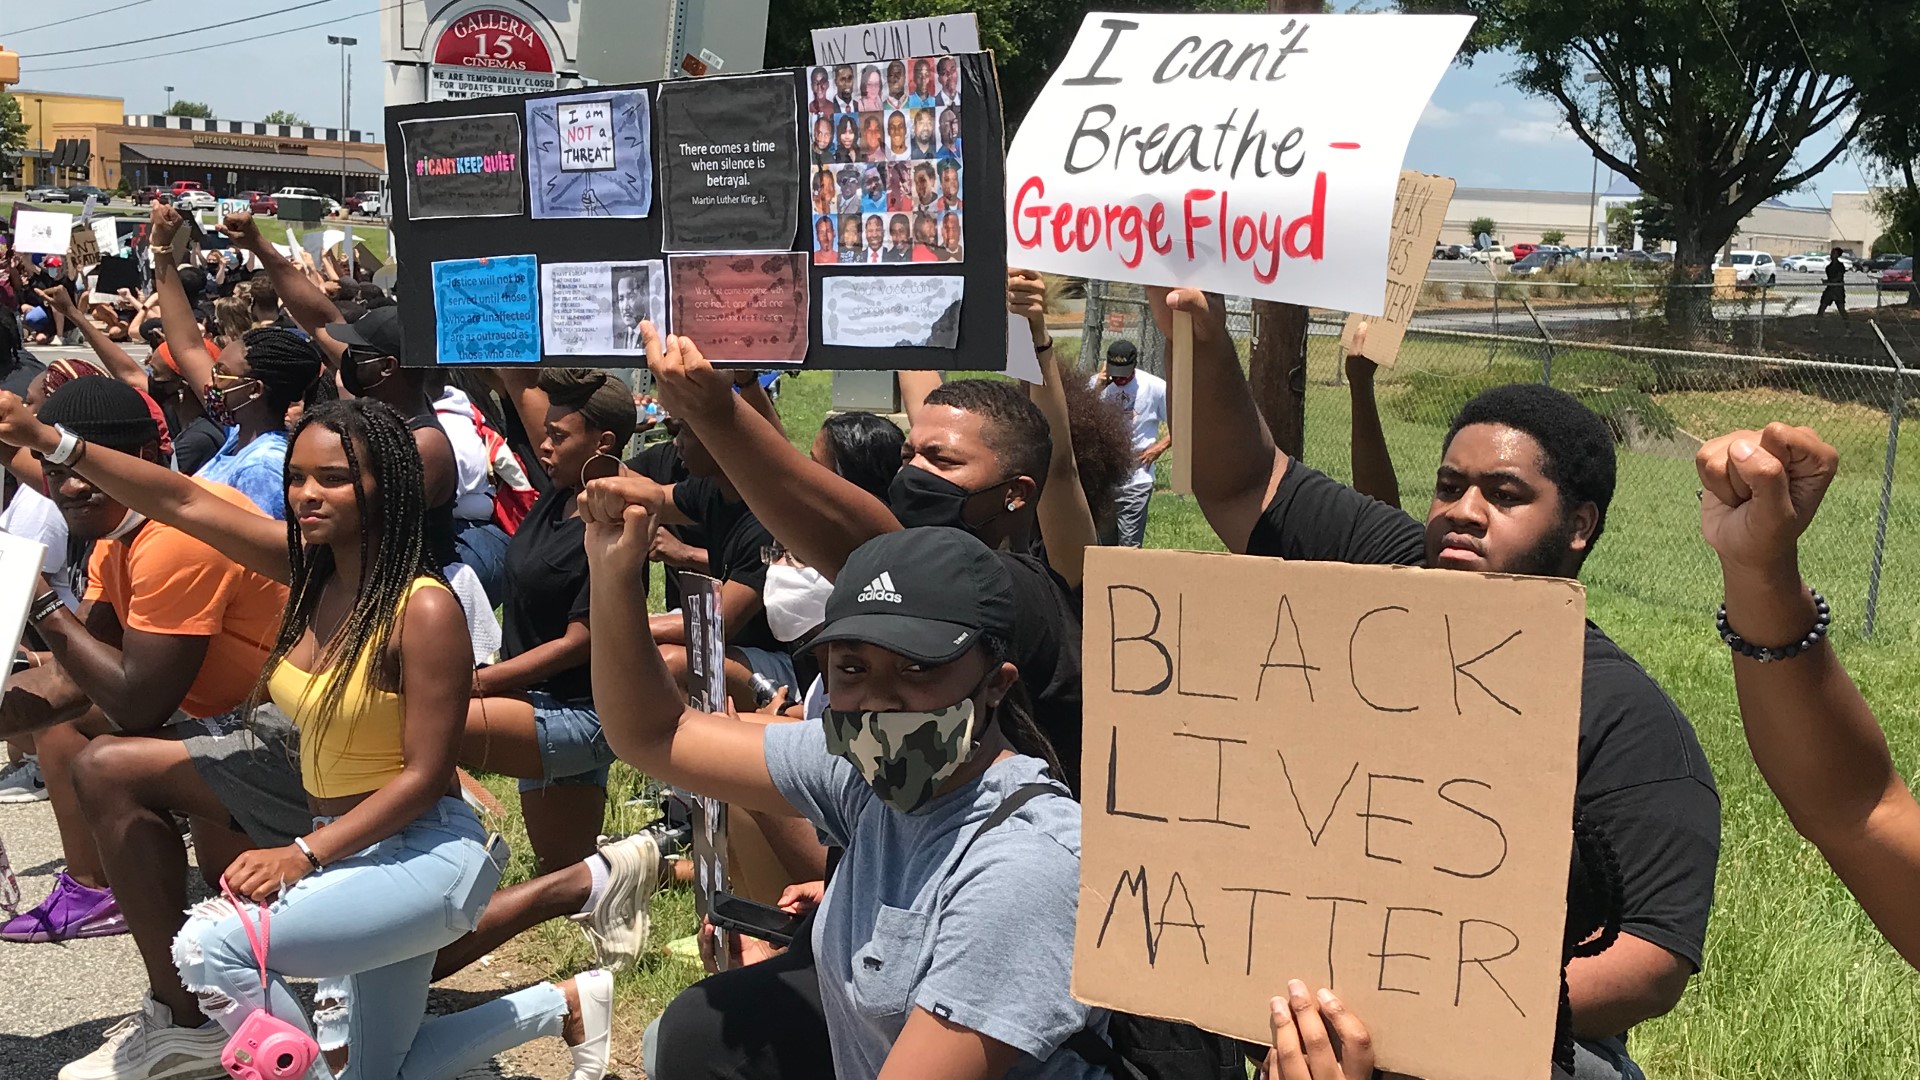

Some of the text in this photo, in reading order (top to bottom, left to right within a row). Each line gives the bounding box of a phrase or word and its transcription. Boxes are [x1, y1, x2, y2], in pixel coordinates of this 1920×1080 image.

[454, 13, 535, 48] GALLERIA
[475, 33, 514, 59] 15
[821, 33, 846, 65] MY
[1062, 18, 1310, 86] I can't
[463, 57, 526, 70] CINEMAS
[433, 71, 554, 88] WE ARE TEMPORARILY CLOSED
[439, 81, 454, 89] FOR
[458, 83, 493, 92] UPDATES
[569, 109, 603, 123] I am
[193, 135, 229, 146] BUFFALO
[230, 138, 251, 148] WILD
[567, 126, 607, 143] NOT a
[1063, 103, 1307, 180] Breathe
[679, 140, 775, 155] There comes a time
[564, 147, 611, 164] THREAT
[691, 156, 766, 171] when silence is
[706, 173, 751, 188] betrayal.
[692, 196, 715, 205] Martin
[716, 195, 739, 204] Luther
[759, 195, 768, 204] Jr.
[1013, 170, 1326, 284] George Floyd
[447, 274, 526, 288] Justice will not be
[449, 293, 527, 306] served until those
[447, 311, 531, 324] who are unaffected
[451, 330, 529, 343] are as outraged as
[459, 350, 483, 361] those
[484, 348, 504, 359] who
[857, 589, 903, 604] adidas
[1108, 584, 1522, 714] BLACK
[1106, 725, 1508, 879] LIVES
[1096, 864, 1526, 1018] MATTER
